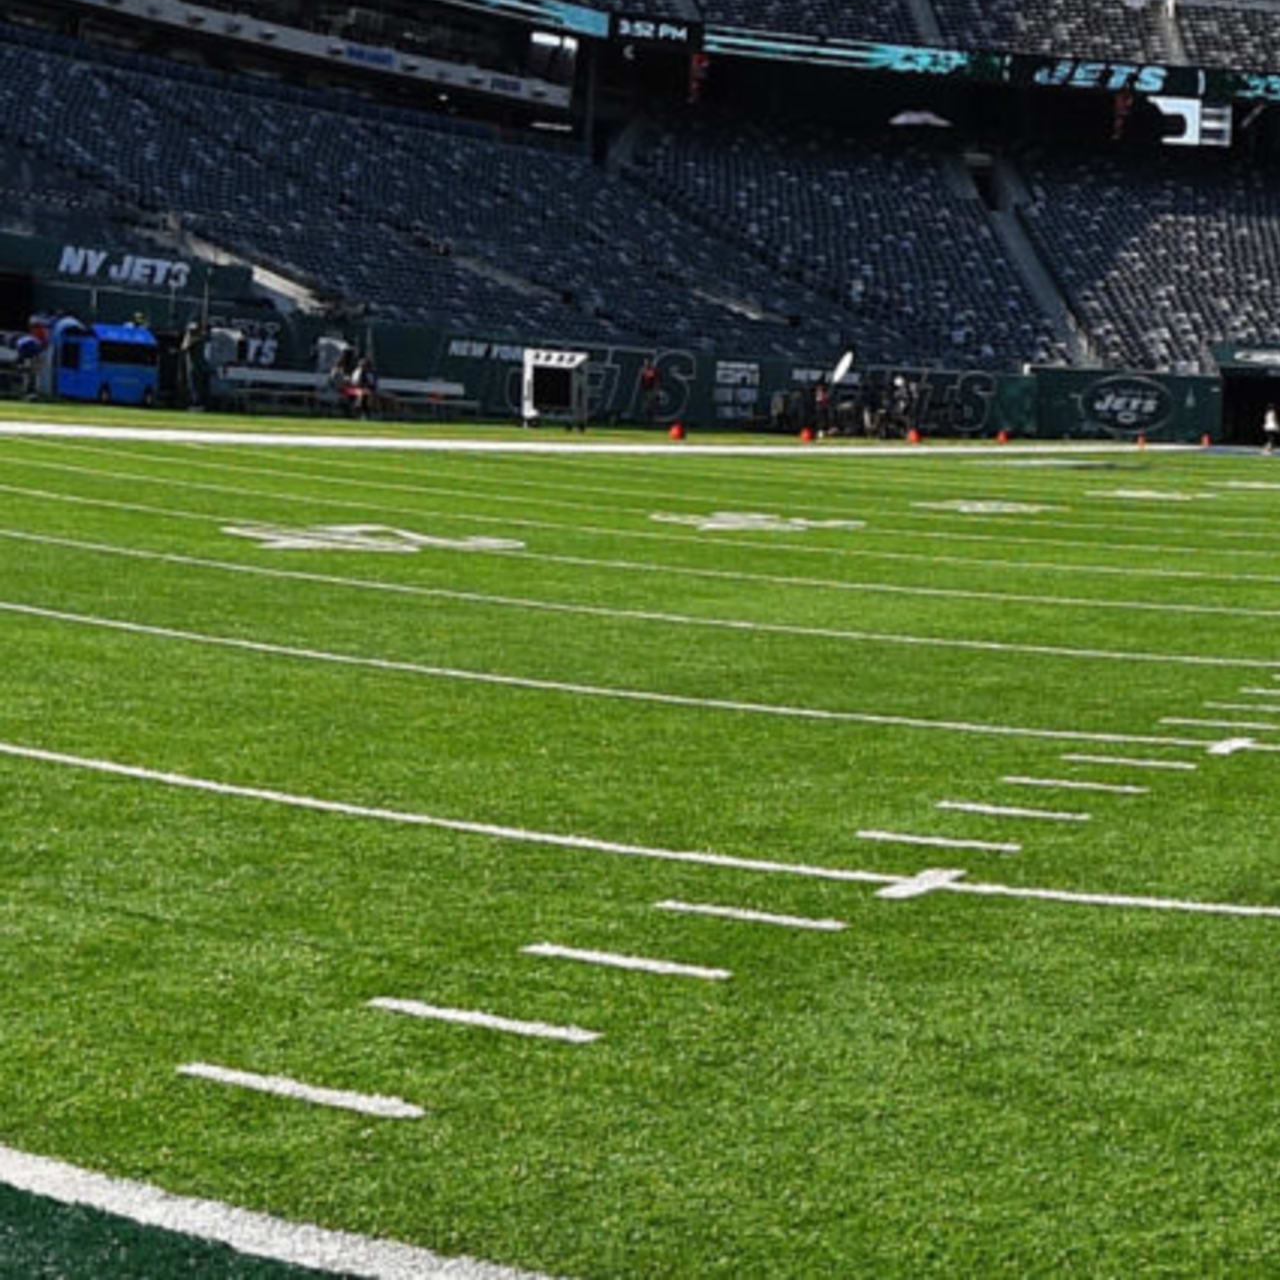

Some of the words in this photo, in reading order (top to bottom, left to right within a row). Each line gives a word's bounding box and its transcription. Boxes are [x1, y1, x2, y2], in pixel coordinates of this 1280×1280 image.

[1034, 60, 1168, 92] JETS
[59, 245, 107, 276] NY
[109, 255, 191, 288] JETS
[1094, 392, 1158, 413] JETS
